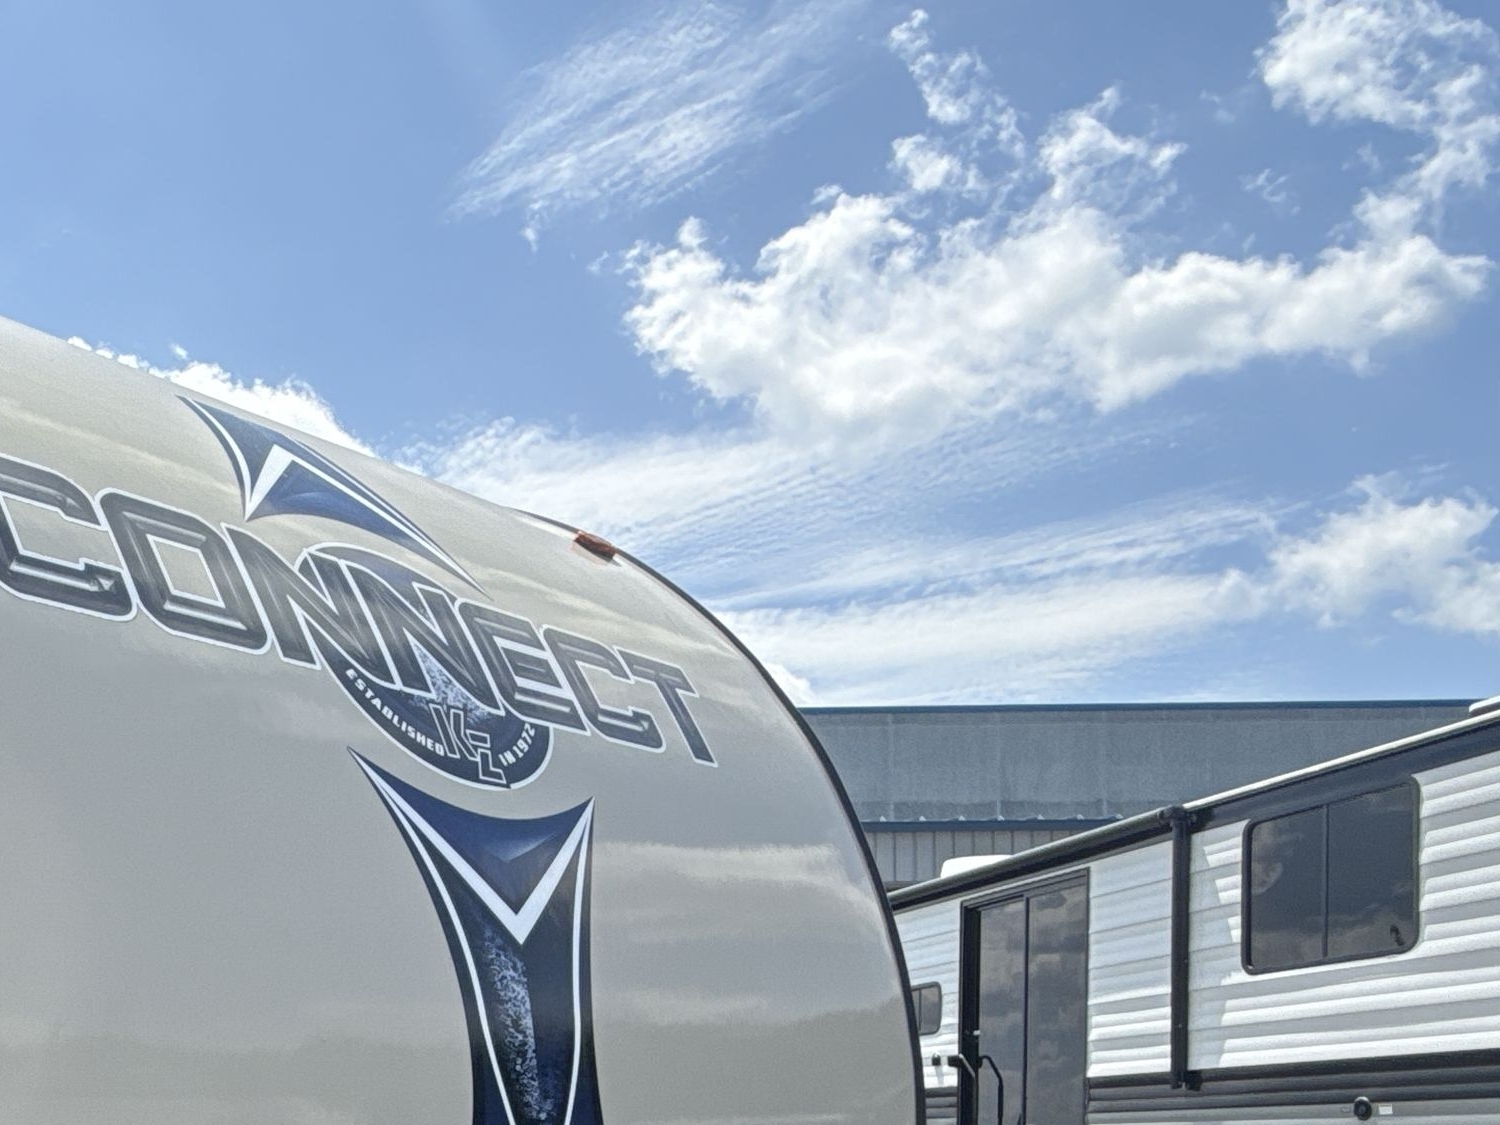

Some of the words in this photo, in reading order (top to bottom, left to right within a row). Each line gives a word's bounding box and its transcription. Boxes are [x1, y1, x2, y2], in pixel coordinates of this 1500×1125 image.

[345, 668, 445, 757] ESTABLISHED
[499, 752, 517, 767] IN
[512, 722, 536, 759] 1972
